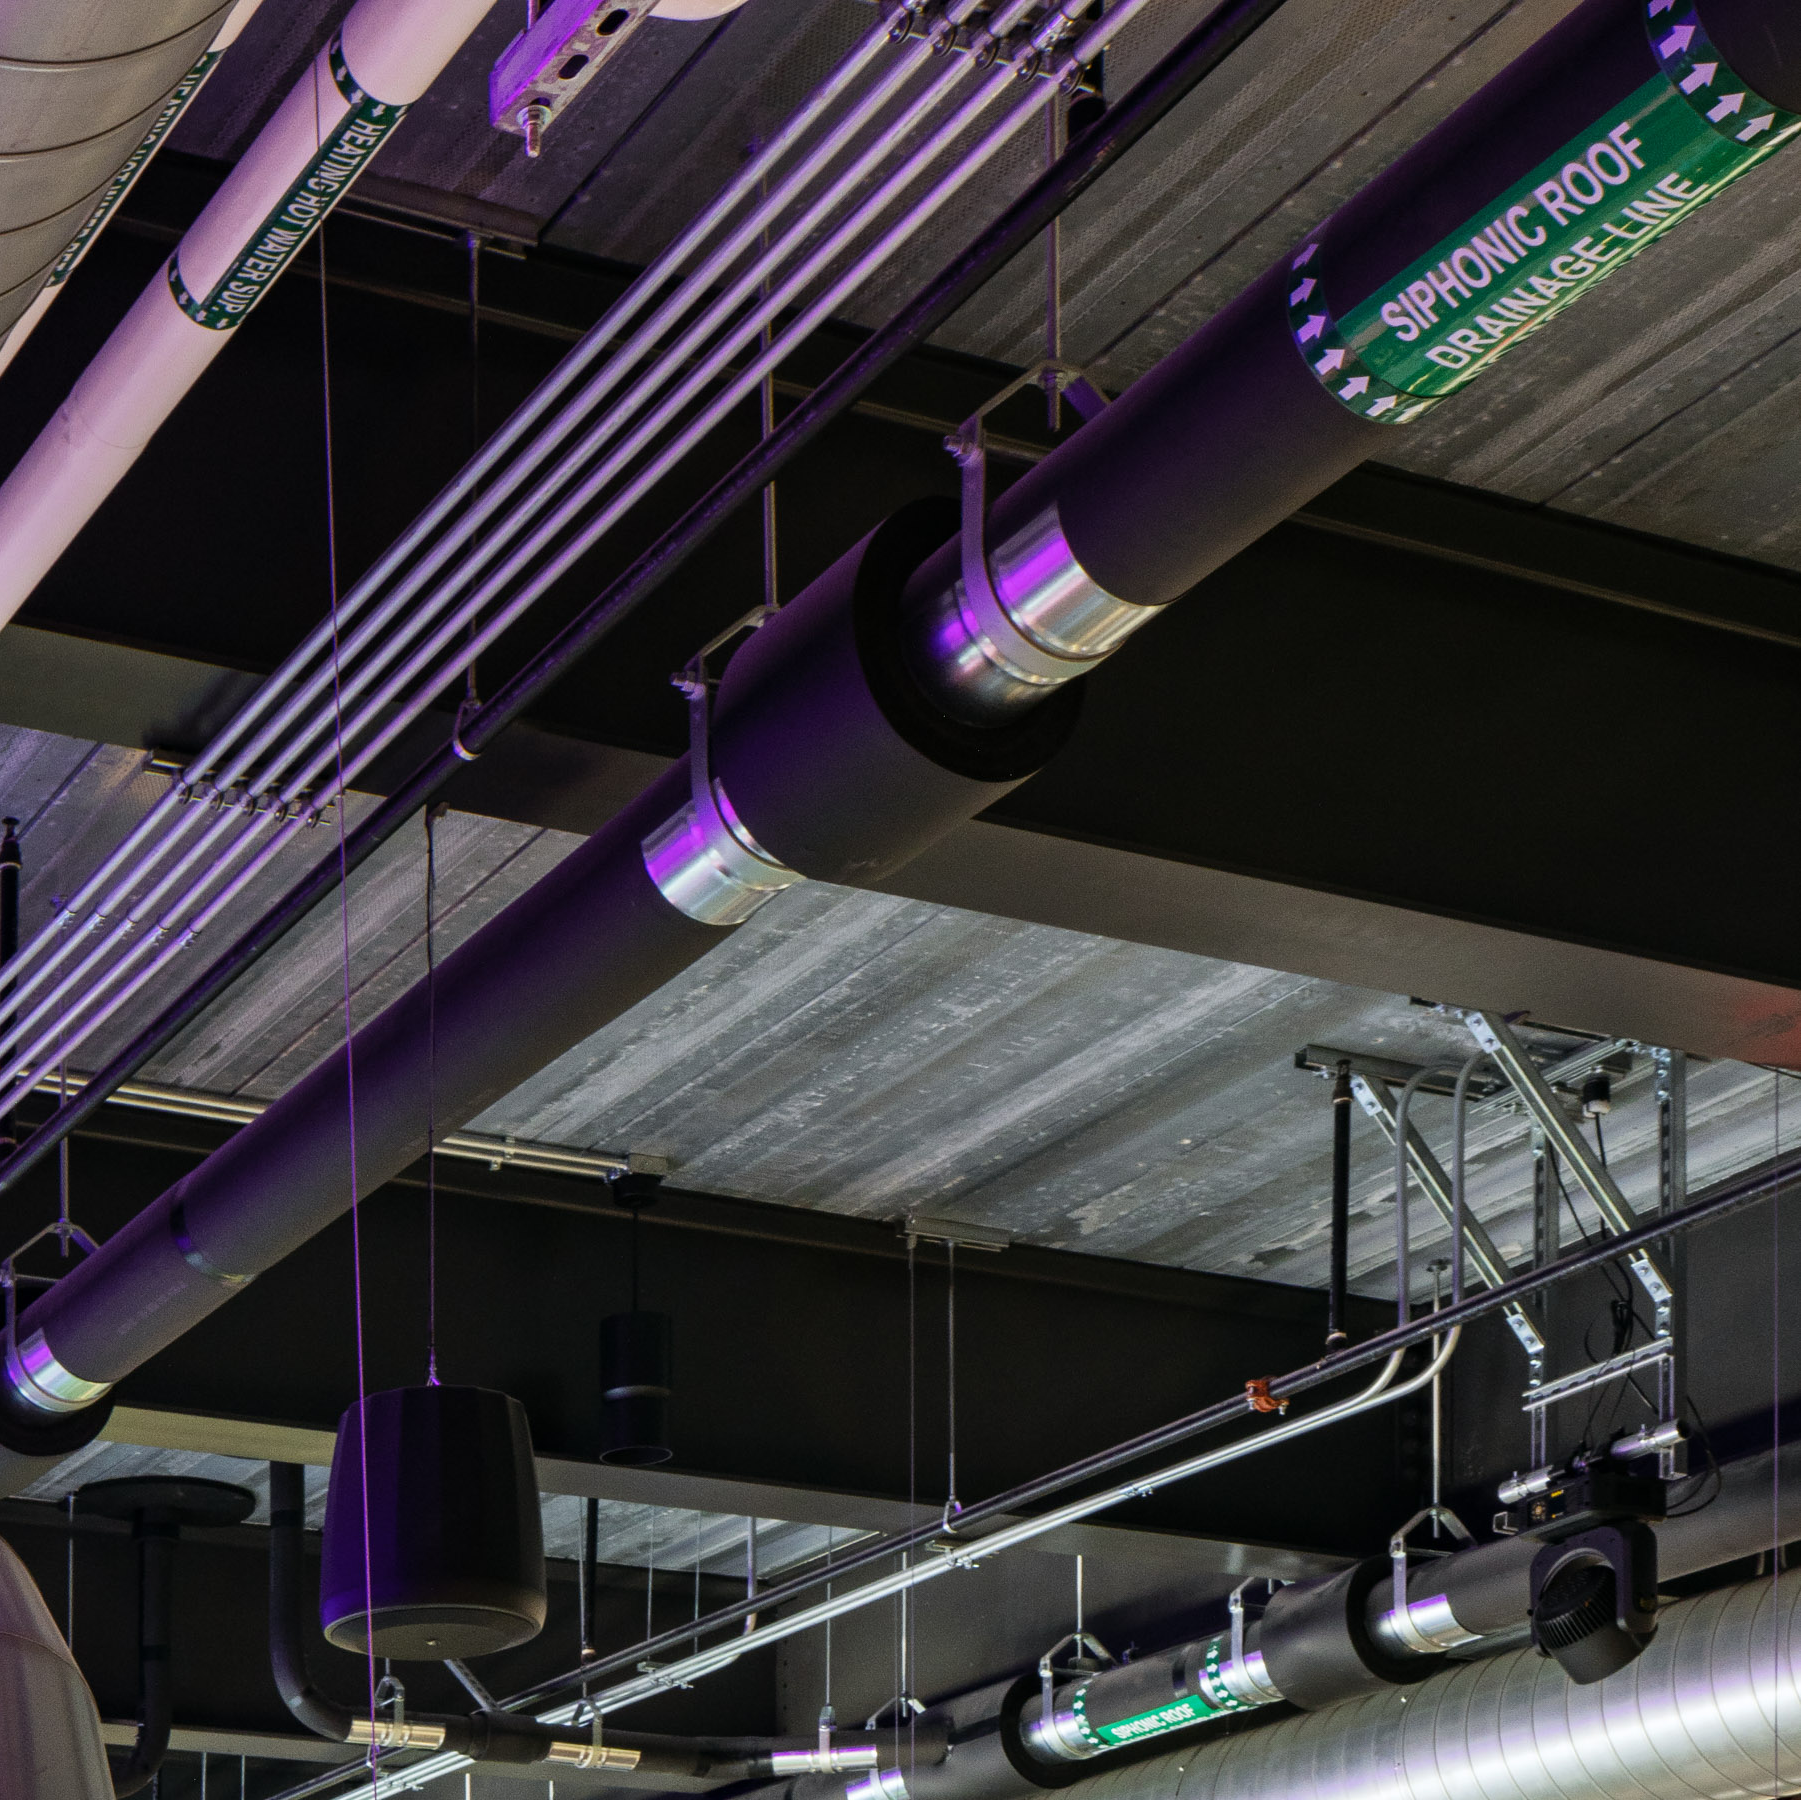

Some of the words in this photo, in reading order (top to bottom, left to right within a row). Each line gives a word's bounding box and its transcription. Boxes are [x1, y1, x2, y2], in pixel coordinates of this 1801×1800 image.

[307, 118, 387, 194] HEATING
[280, 188, 330, 236] HOT
[1380, 205, 1547, 343] SIPHONIC
[1533, 121, 1646, 226] ROOF
[238, 230, 304, 284] WATER
[1425, 236, 1621, 371] DRAINAGE
[1602, 172, 1709, 242] LINE
[212, 279, 259, 315] SUP.
[1111, 1713, 1167, 1740] SIPHONIC
[1159, 1703, 1196, 1724] ROOF
